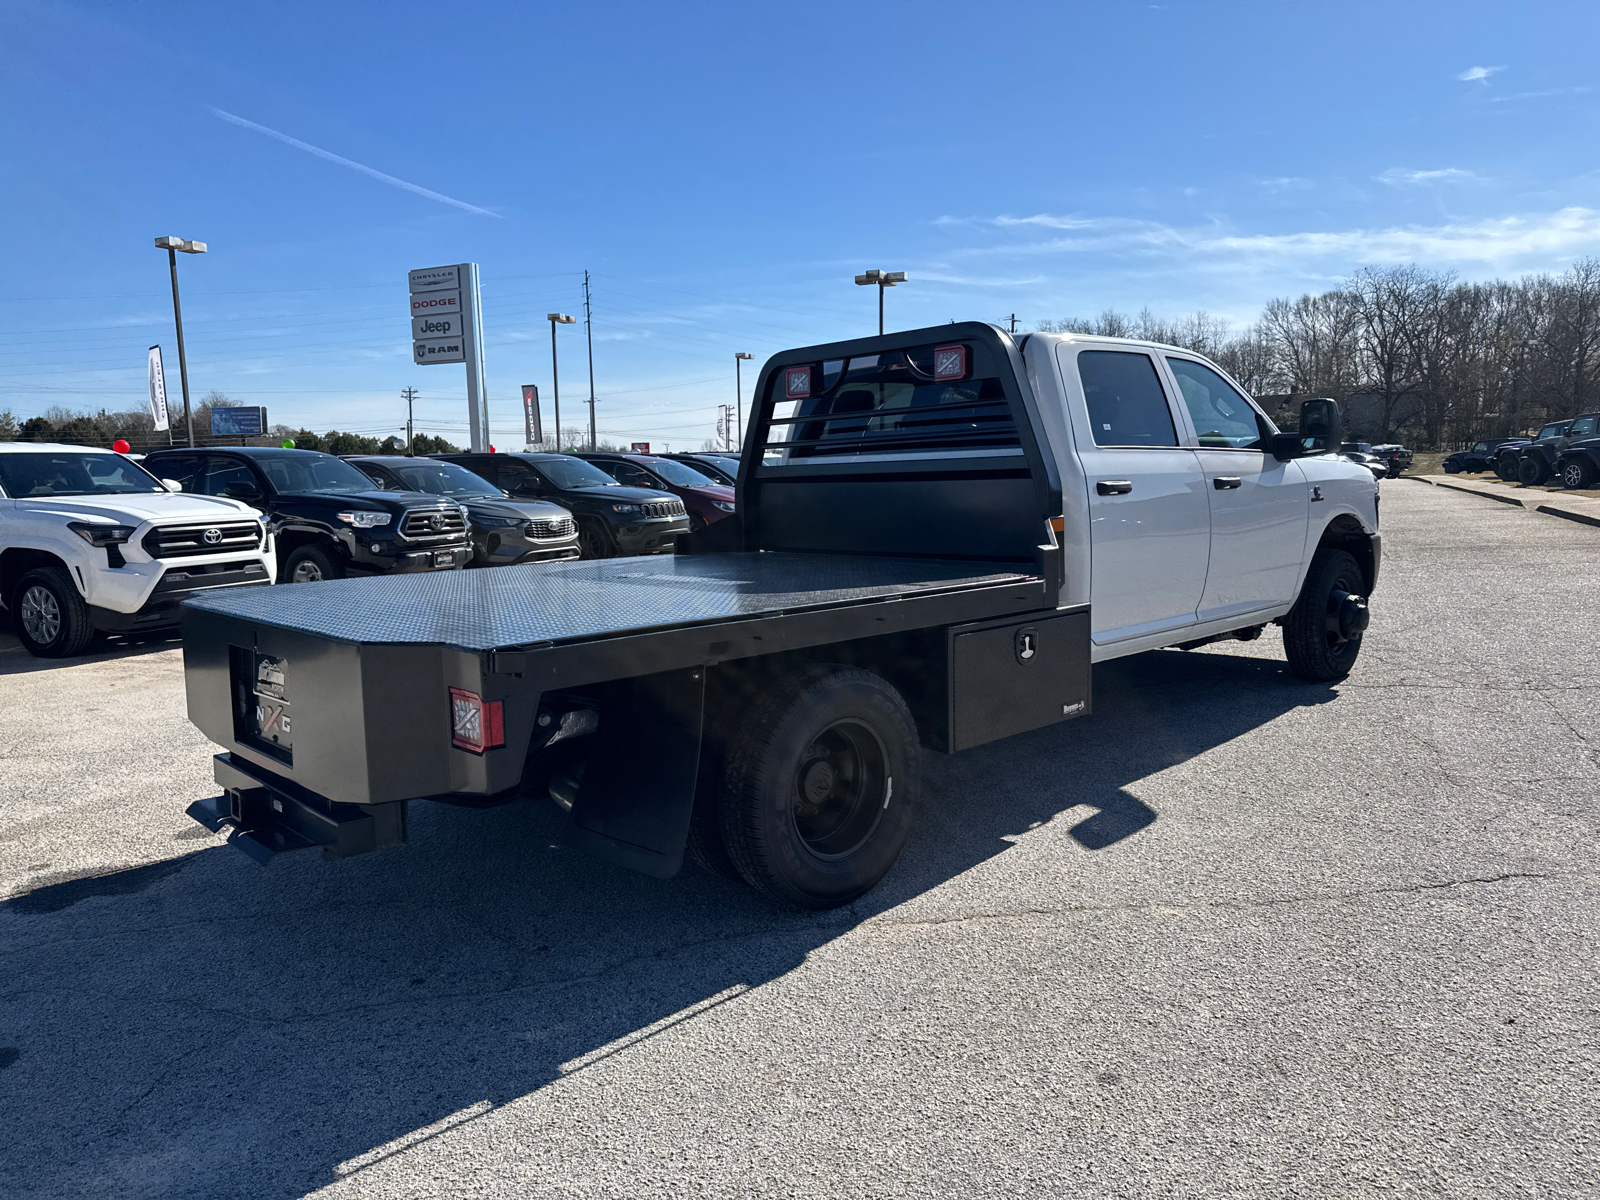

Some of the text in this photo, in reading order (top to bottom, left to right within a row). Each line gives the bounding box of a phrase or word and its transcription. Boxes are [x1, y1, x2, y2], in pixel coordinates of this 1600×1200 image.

[412, 271, 453, 280] CHRYSLER
[413, 298, 456, 309] DODGE
[421, 320, 450, 334] Jeep
[427, 345, 459, 354] RAM
[256, 705, 291, 733] NXG
